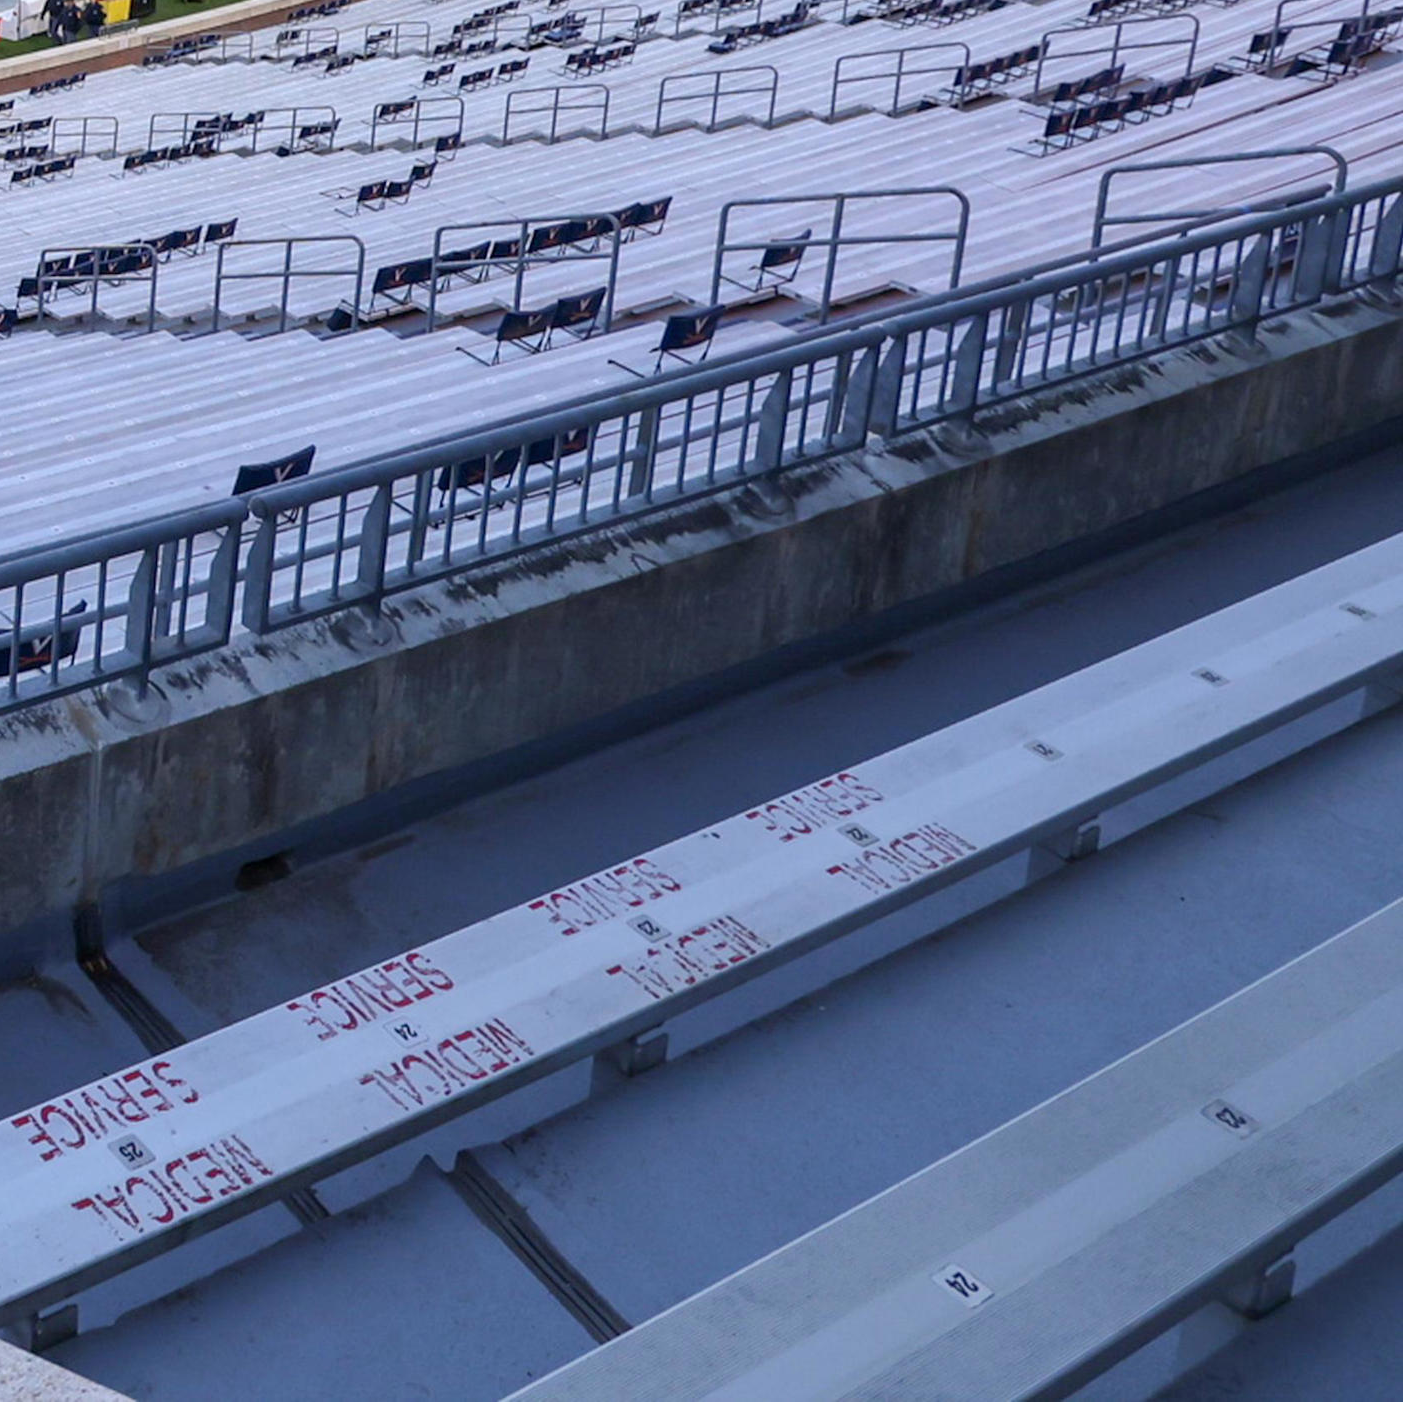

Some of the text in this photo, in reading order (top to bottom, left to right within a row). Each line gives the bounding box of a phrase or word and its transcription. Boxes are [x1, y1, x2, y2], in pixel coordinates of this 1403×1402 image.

[745, 772, 883, 843] SERVICE
[528, 858, 681, 936] SERVICE
[825, 821, 978, 895] MEDICAL
[287, 953, 454, 1041] SERVICE
[605, 915, 771, 999] MEDICAL
[359, 1017, 534, 1111] MEDICAL
[12, 1060, 200, 1162] SERVICE
[70, 1134, 274, 1241] MEDICAL
[118, 1140, 144, 1164] 25
[945, 1271, 980, 1299] 24
